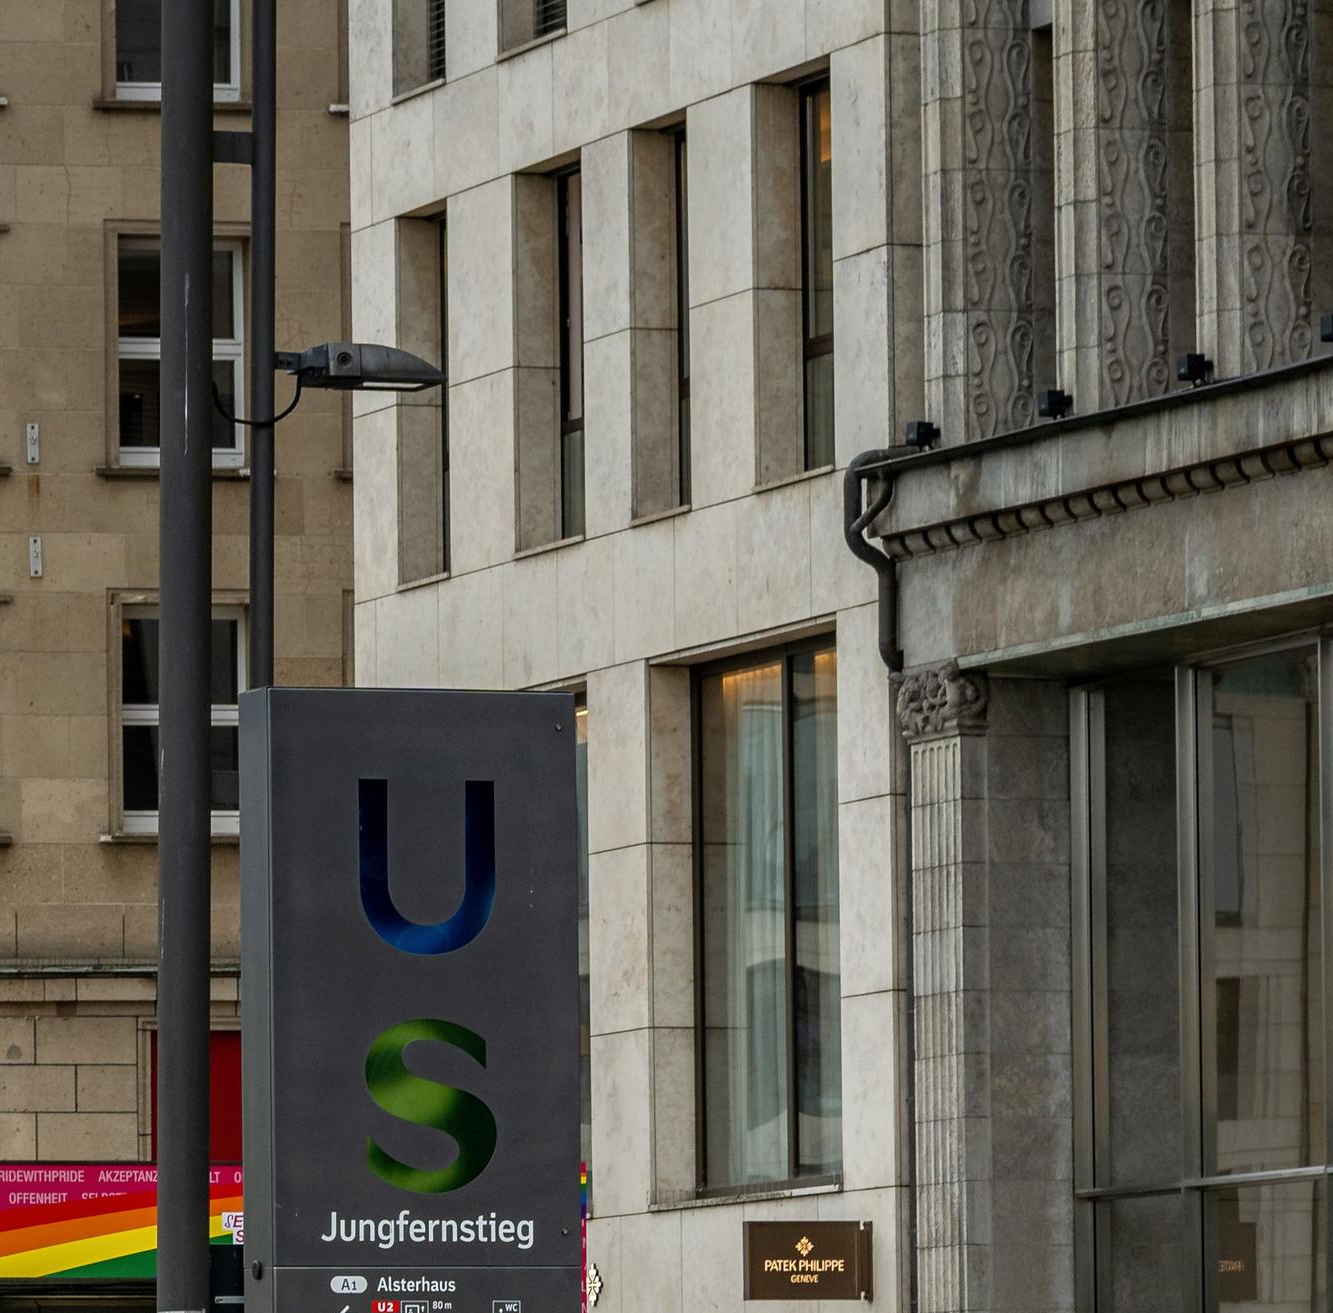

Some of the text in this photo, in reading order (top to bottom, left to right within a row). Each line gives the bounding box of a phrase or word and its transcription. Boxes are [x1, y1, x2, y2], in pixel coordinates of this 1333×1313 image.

[357, 778, 495, 956] U
[365, 1017, 497, 1194] S
[99, 1171, 158, 1183] AKZEPTANZ
[9, 1193, 67, 1205] OFFENHEIT
[321, 1210, 534, 1248] Jungfernstieg
[765, 1260, 844, 1272] PATEK PHILIPPE
[341, 1276, 456, 1292] A1 Alsterhaus
[377, 1301, 452, 1312] U2 80 m
[505, 1304, 518, 1312] WC
